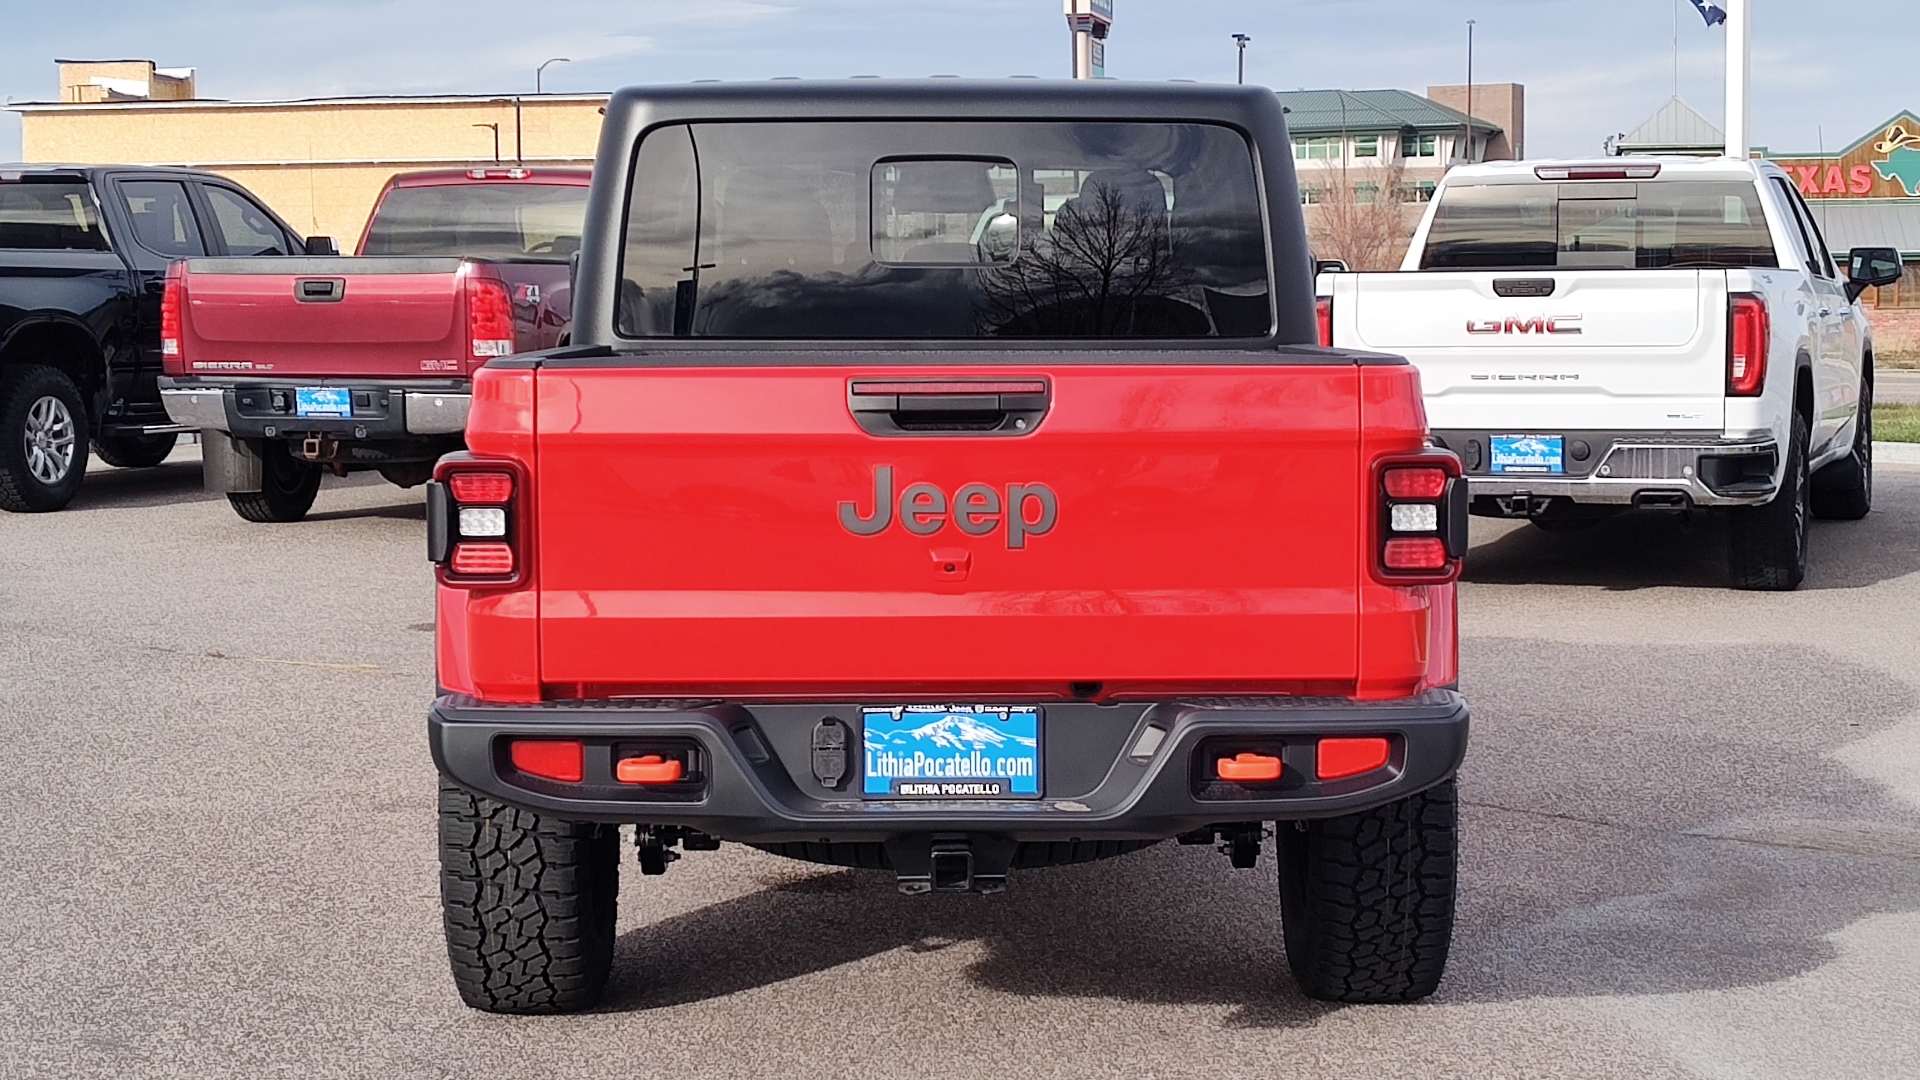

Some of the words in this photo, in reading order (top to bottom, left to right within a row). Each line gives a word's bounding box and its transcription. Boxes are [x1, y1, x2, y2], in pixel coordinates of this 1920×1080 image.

[1466, 314, 1582, 334] GMC
[192, 361, 253, 370] SIERRA
[420, 359, 458, 371] GMC
[837, 464, 1058, 549] Jeep
[866, 750, 1033, 777] LithiaPocatello.com
[941, 784, 1000, 795] POCATELLO
